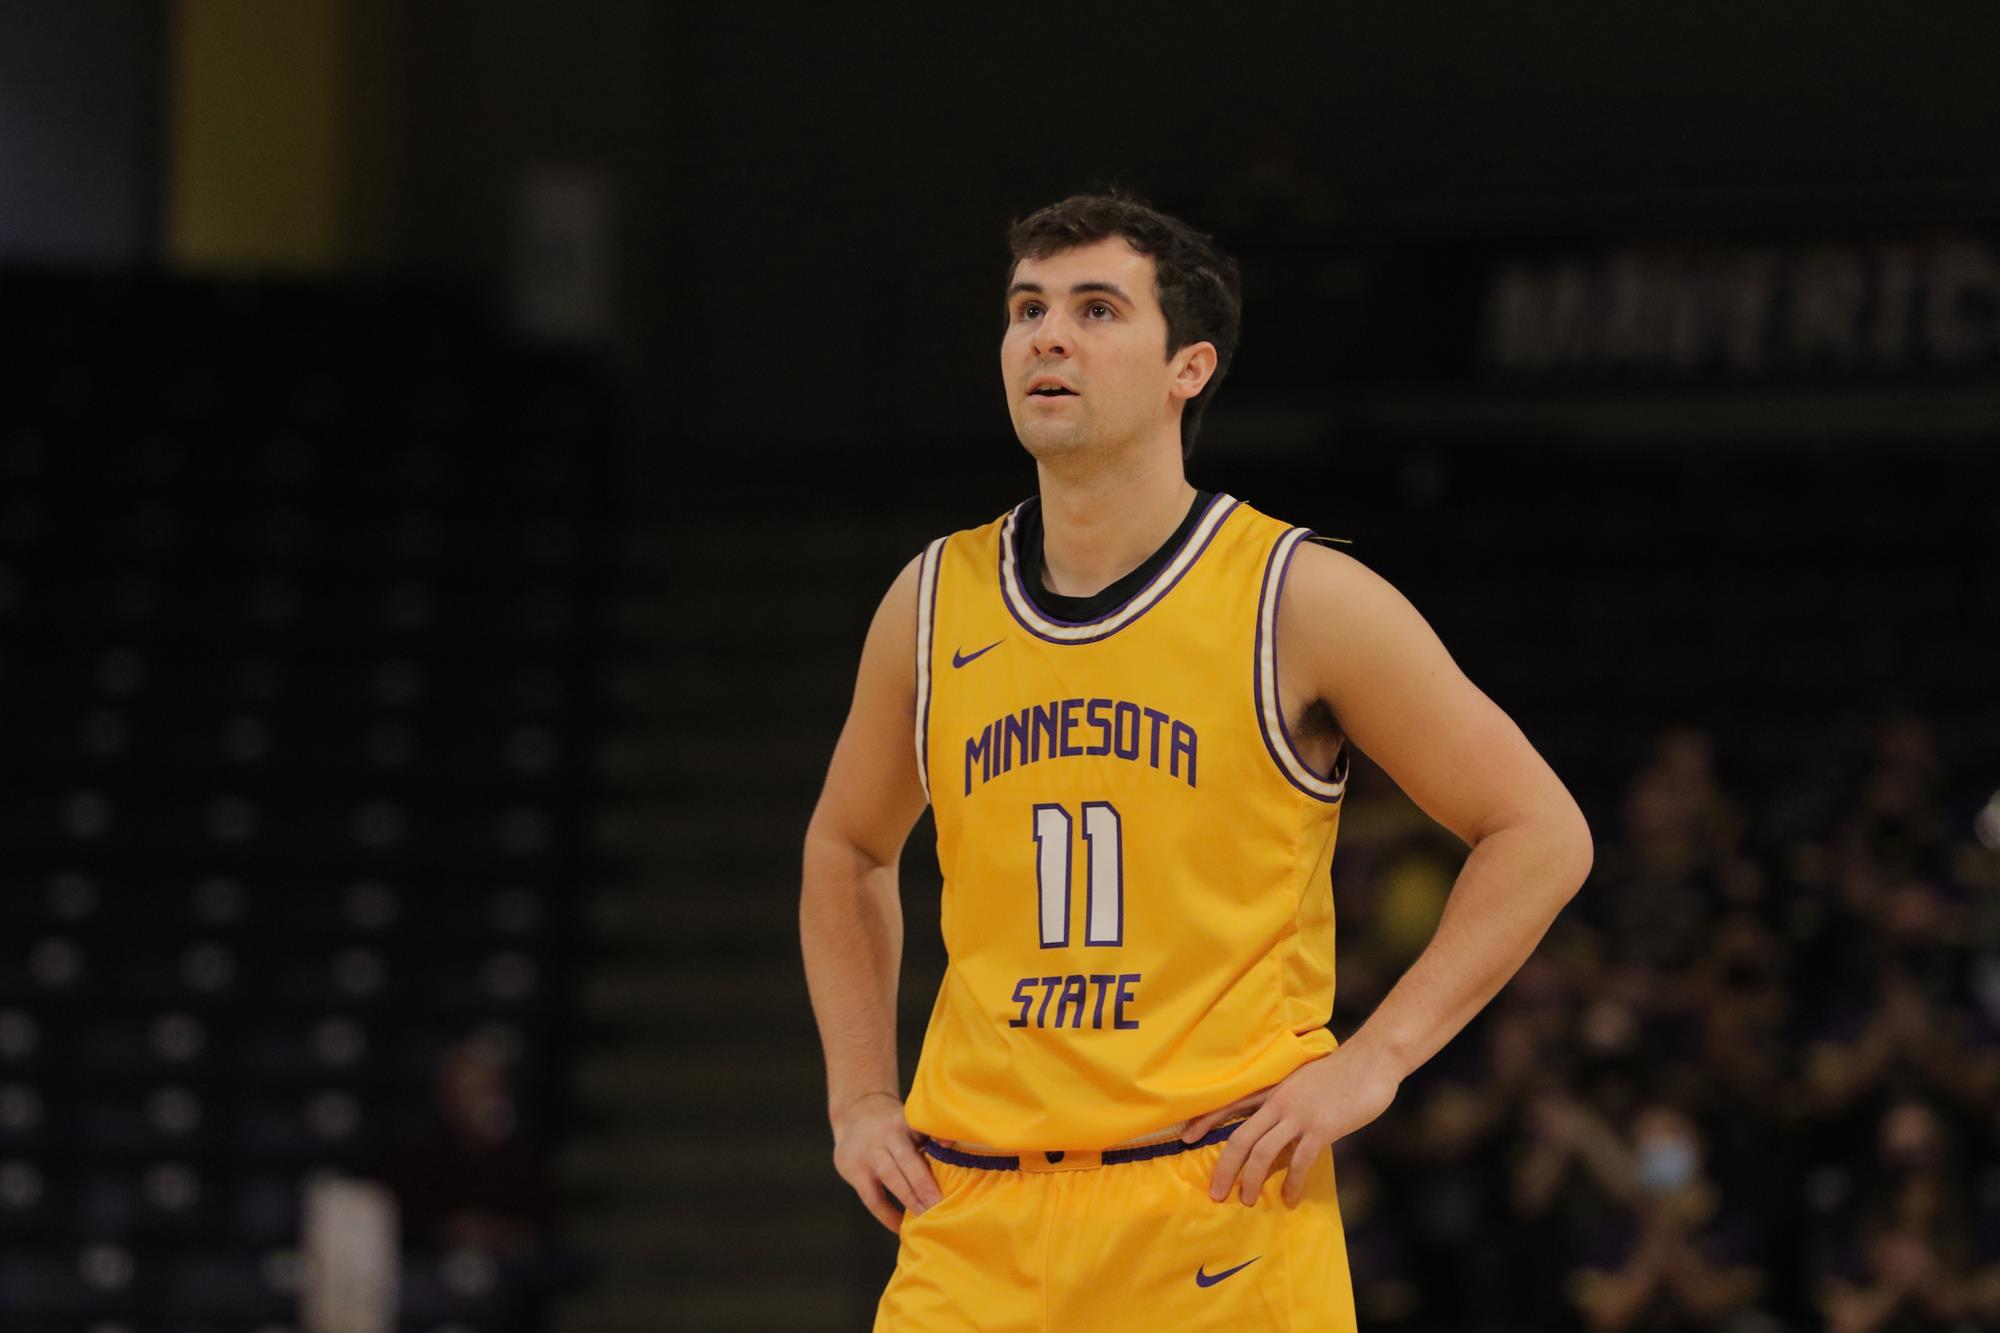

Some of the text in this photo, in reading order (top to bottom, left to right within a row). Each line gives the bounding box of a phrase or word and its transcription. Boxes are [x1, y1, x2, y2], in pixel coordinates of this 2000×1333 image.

[964, 698, 1197, 797] MINNESOTA
[1033, 801, 1123, 948] 11
[1009, 974, 1141, 1029] STATE
